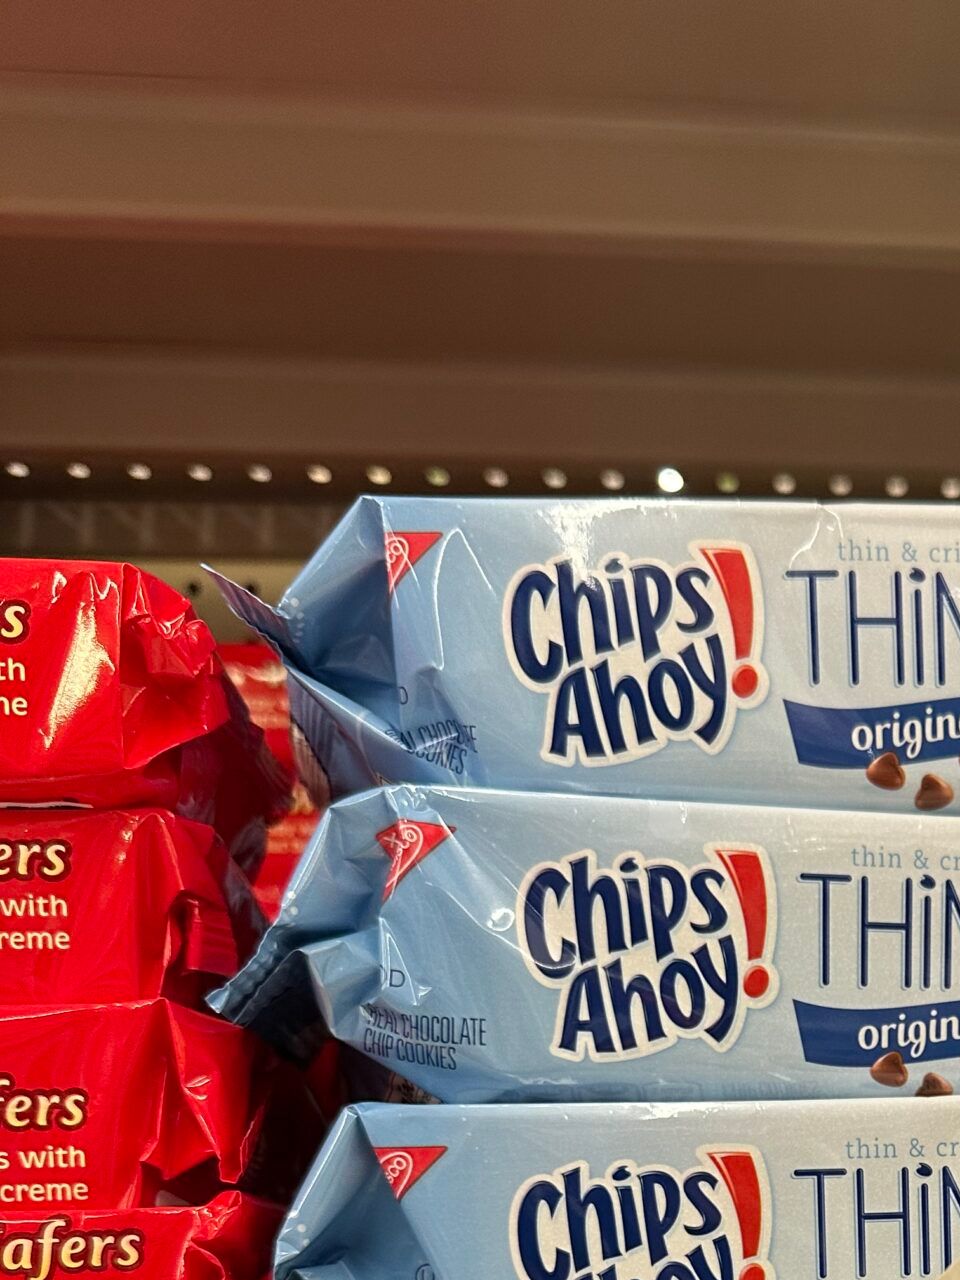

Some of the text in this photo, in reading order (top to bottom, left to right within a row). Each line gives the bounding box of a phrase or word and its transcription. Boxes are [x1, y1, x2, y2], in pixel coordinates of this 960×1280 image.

[837, 541, 890, 562] thin
[511, 557, 715, 684] Chips
[851, 847, 903, 869] thin
[1, 893, 68, 917] with
[525, 855, 728, 980] Chips
[401, 1012, 487, 1047] CHOCOLATE
[364, 1028, 457, 1071] CHIP COOKIES
[18, 1146, 86, 1170] with
[845, 1137, 897, 1160] thin
[1, 1182, 89, 1202] creme
